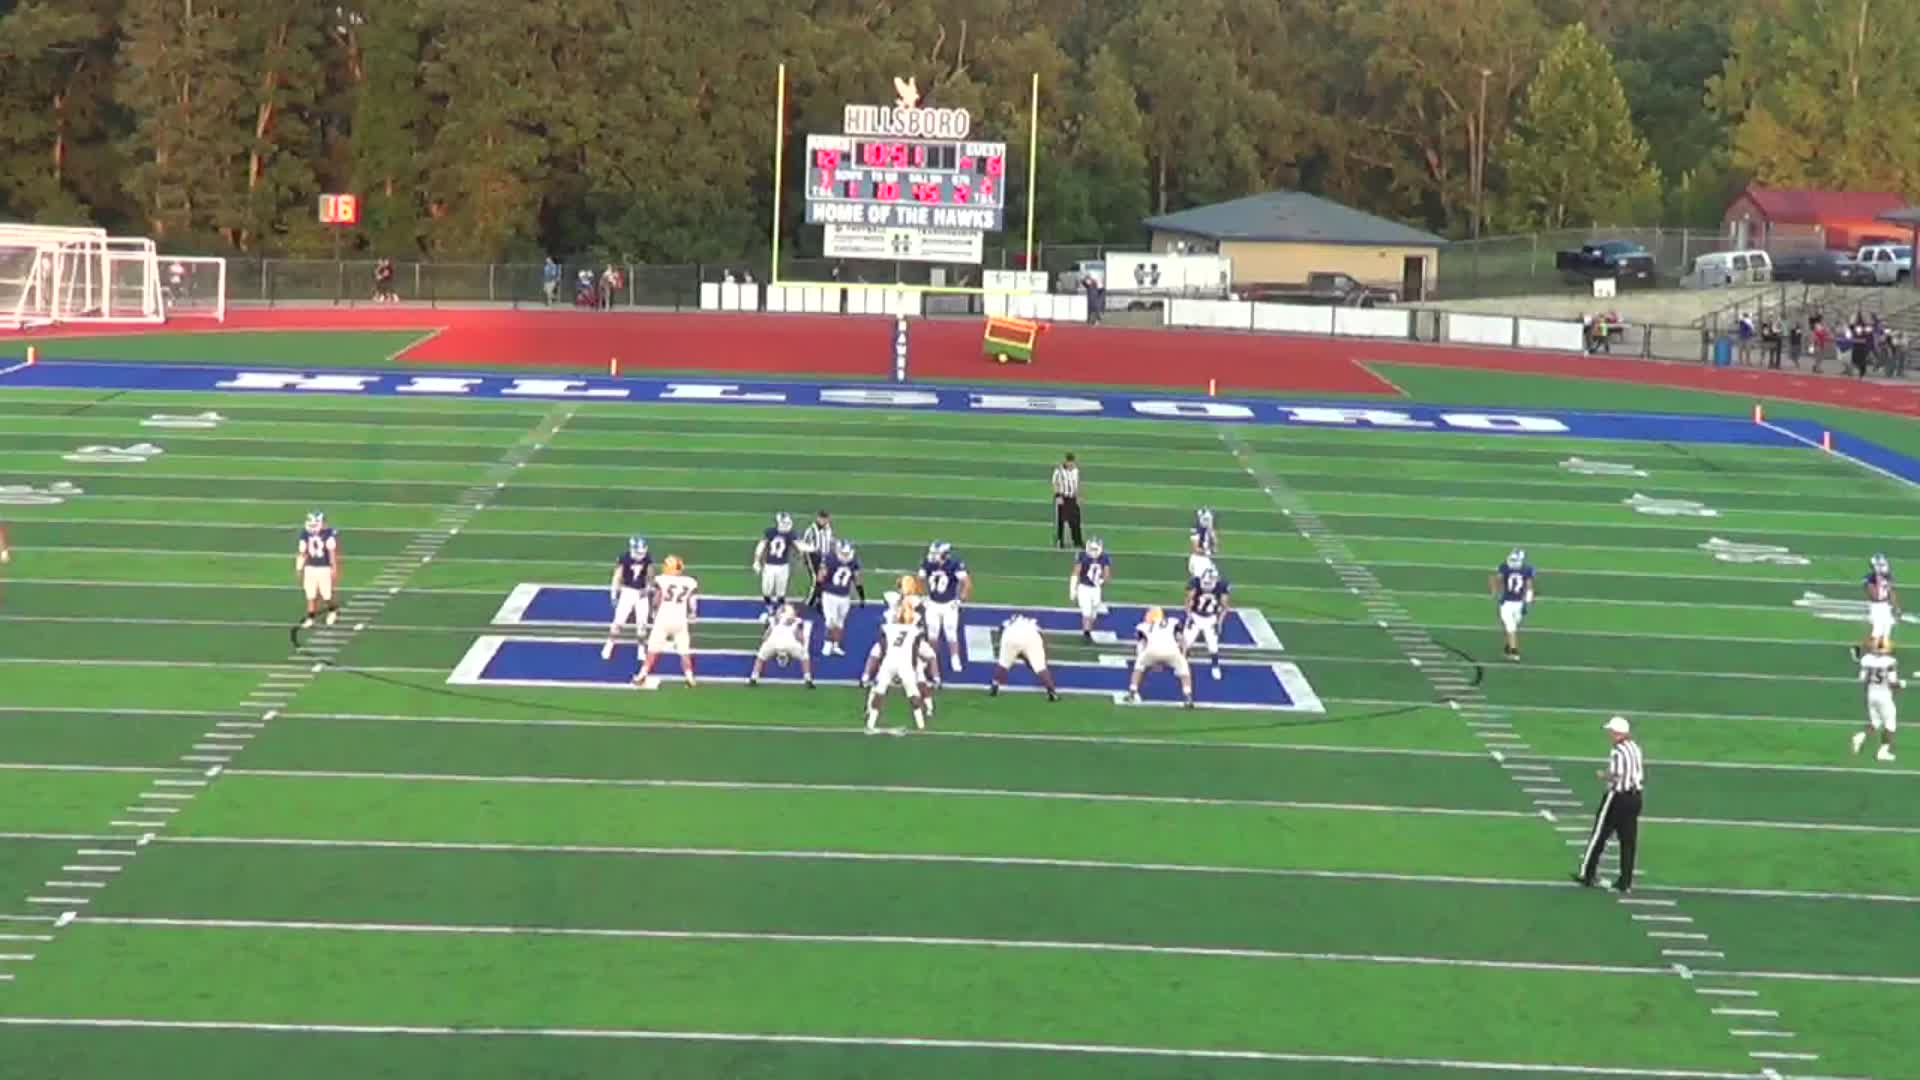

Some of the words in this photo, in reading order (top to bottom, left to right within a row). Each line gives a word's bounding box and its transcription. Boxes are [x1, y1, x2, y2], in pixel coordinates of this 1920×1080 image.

[845, 103, 970, 138] HILLSBORO
[812, 203, 864, 223] HOME
[867, 206, 891, 224] OF
[896, 207, 929, 225] THE
[933, 210, 994, 228] HAWKS
[213, 370, 1571, 435] HILLSBORO
[664, 584, 689, 603] 52
[893, 631, 908, 647] 3
